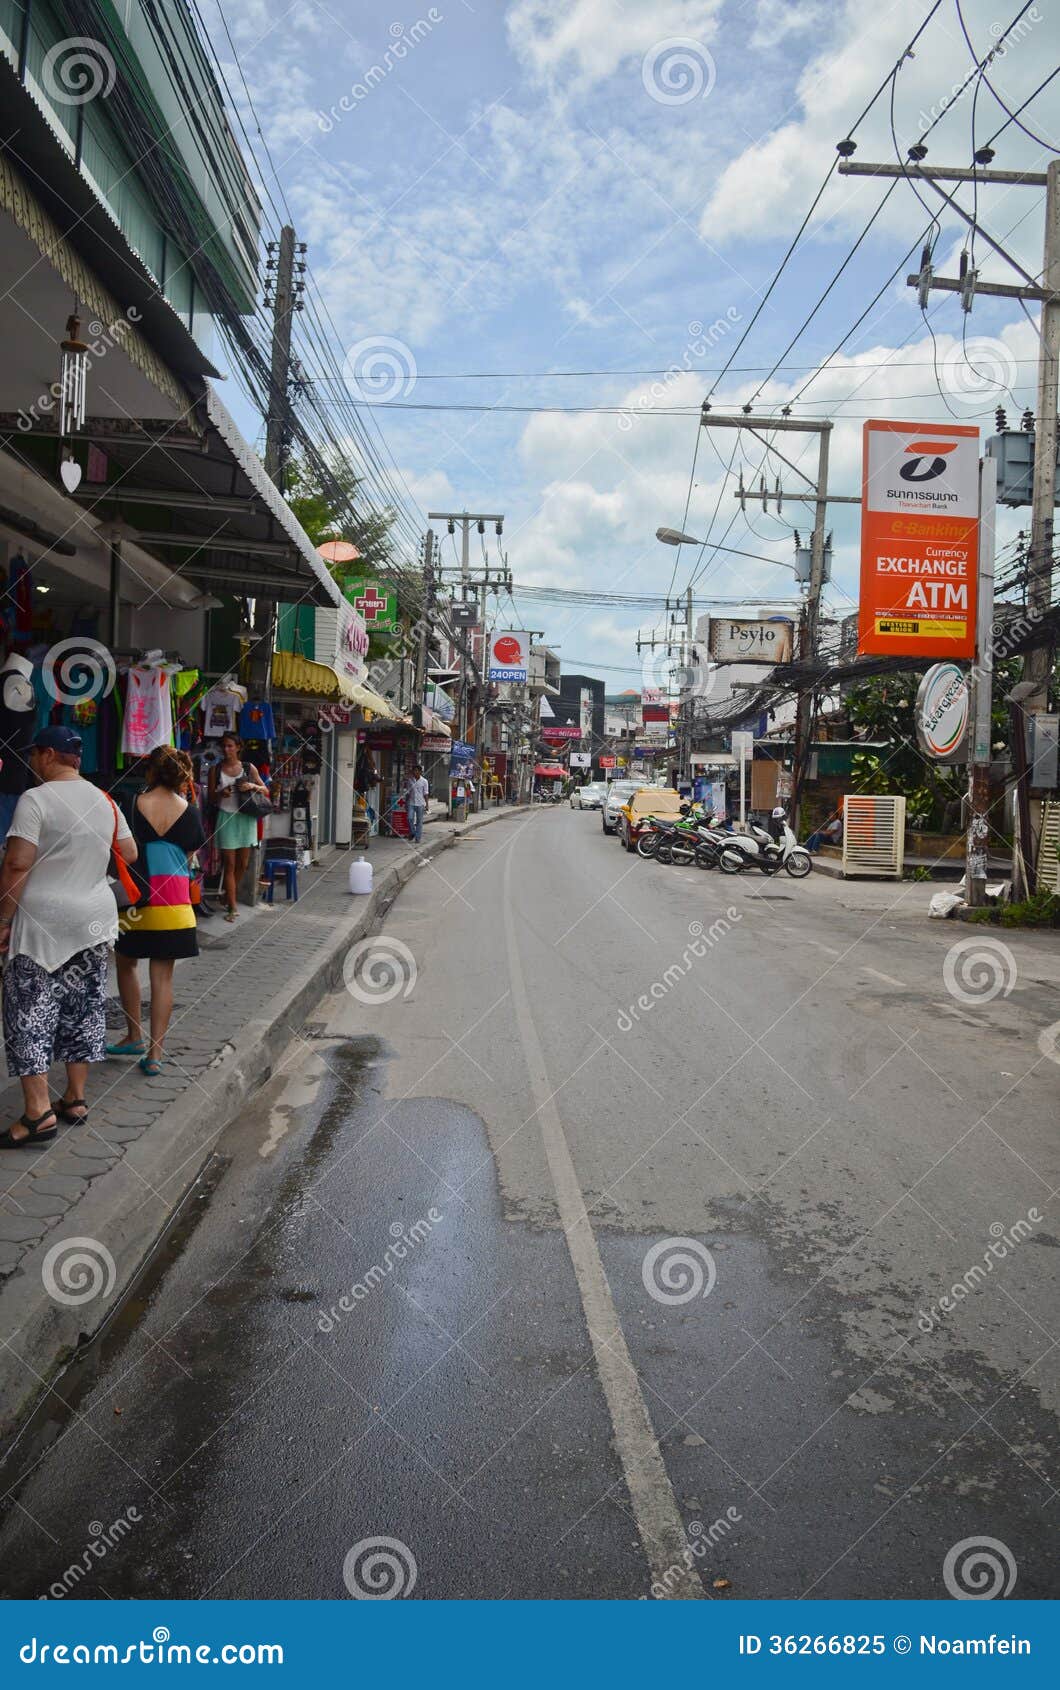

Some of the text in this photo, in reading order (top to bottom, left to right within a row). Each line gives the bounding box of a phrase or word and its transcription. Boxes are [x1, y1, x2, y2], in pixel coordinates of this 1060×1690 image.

[891, 520, 968, 538] e-Banking
[926, 546, 968, 560] Currency
[877, 556, 967, 577] EXCHANGE
[906, 581, 968, 610] ATM
[729, 625, 775, 651] Psylo
[925, 674, 964, 731] Evergreen
